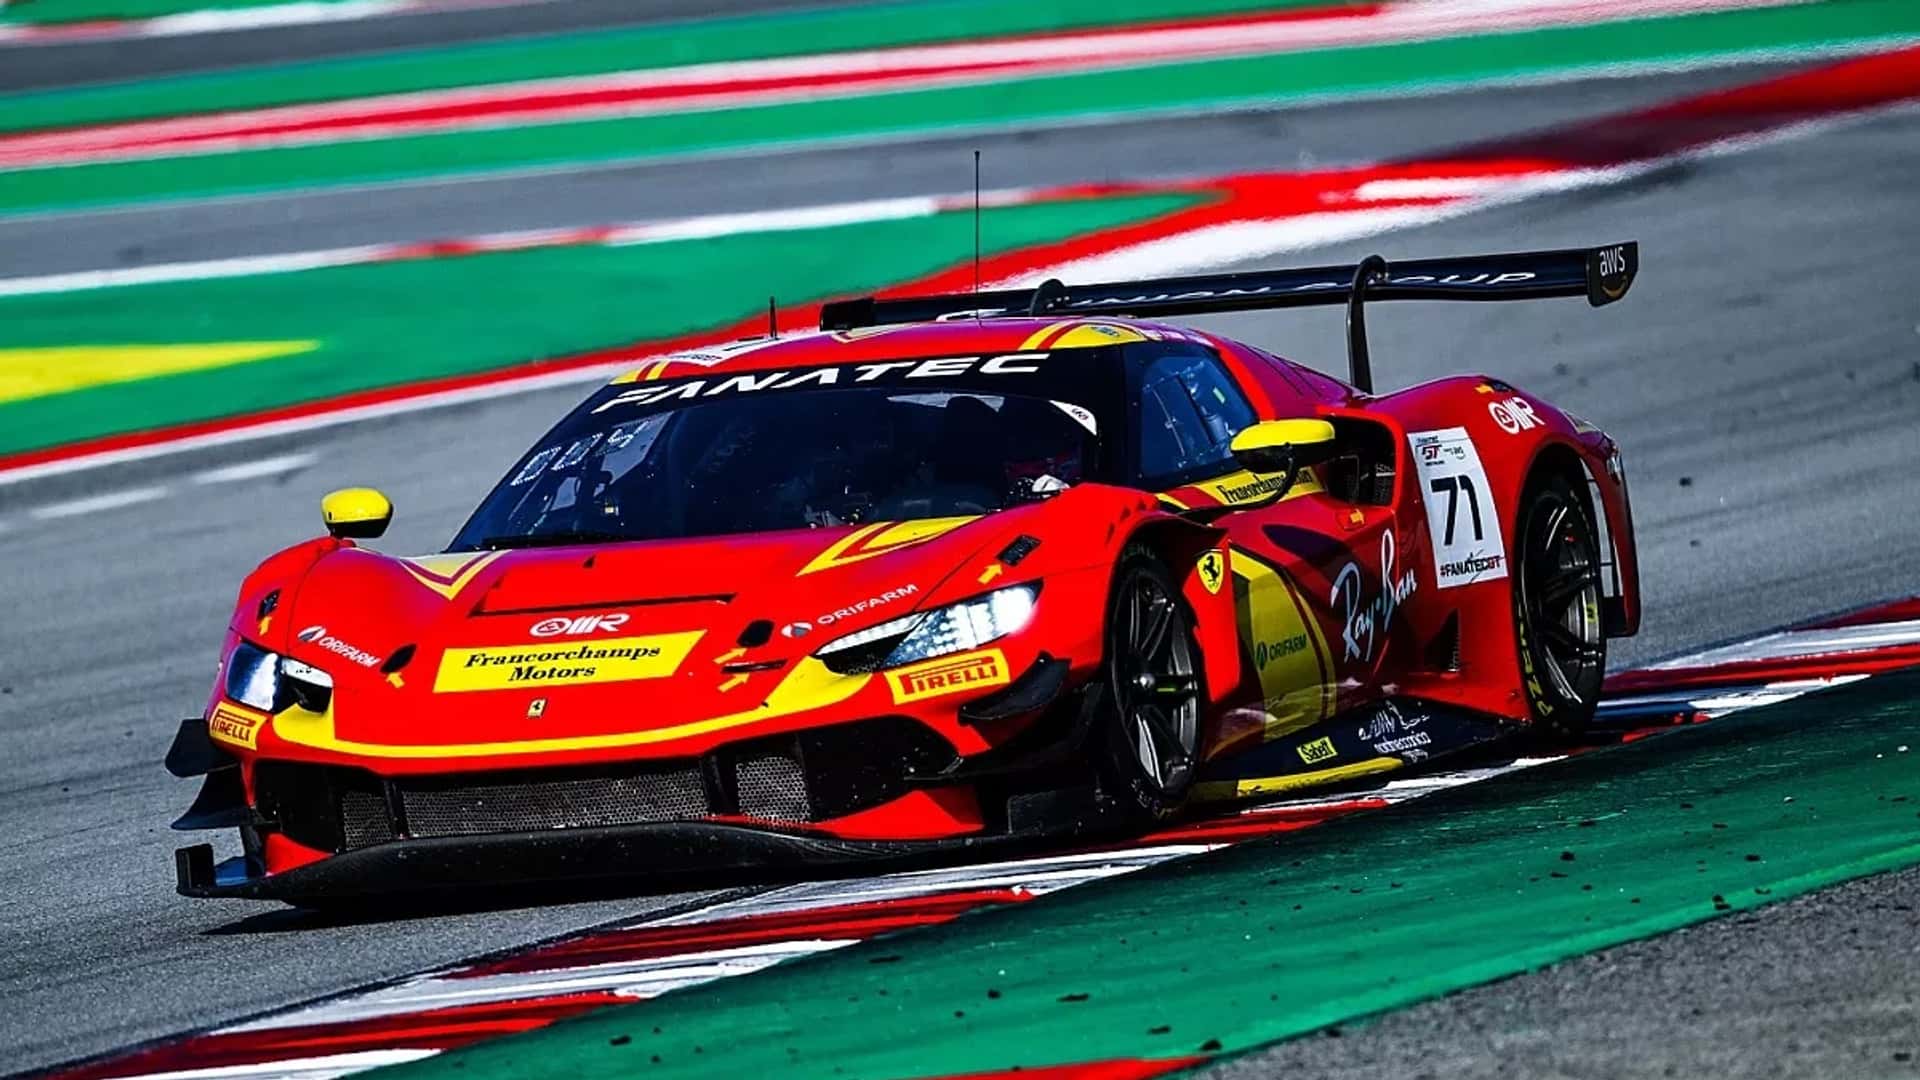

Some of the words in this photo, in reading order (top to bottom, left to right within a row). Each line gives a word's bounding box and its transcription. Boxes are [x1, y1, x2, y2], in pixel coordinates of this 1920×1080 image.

[1599, 246, 1626, 277] aws
[591, 353, 1050, 414] FANATEC
[1431, 474, 1483, 546] 71
[1440, 555, 1500, 577] #FANATECGT
[817, 583, 919, 625] ORIFARM
[318, 636, 381, 667] ORIFARM
[464, 645, 661, 669] Francorchamps
[507, 665, 597, 682] Motors
[898, 655, 998, 696] PIRELLI
